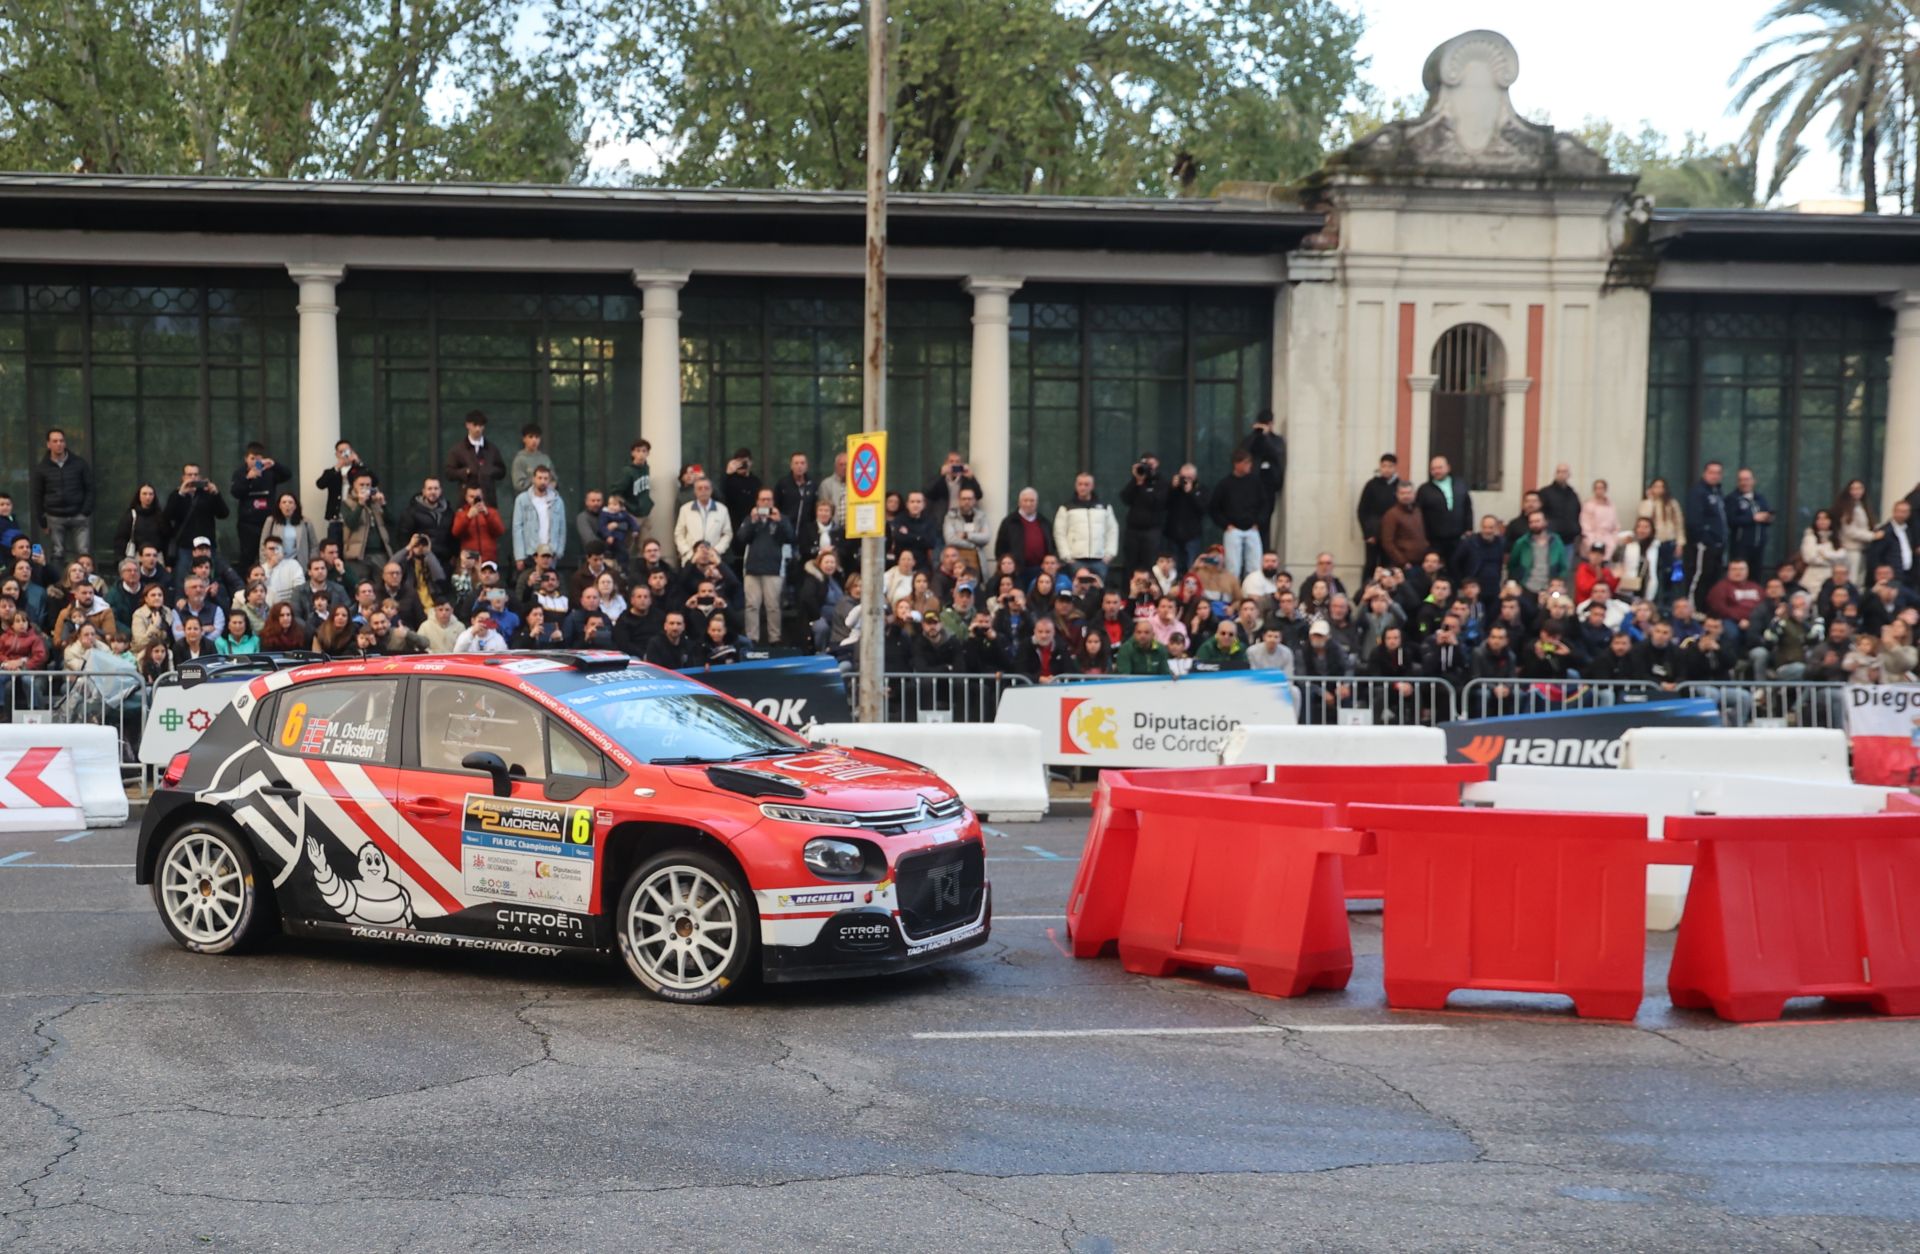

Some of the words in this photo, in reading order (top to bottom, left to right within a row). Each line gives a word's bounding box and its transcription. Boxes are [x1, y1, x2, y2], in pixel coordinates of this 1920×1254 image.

[281, 702, 308, 747] 6
[326, 721, 339, 738] M.
[340, 723, 387, 745] Østberg
[518, 681, 633, 767] boutique.citroenracing.com
[322, 738, 331, 755] T.
[331, 739, 374, 758] Eriksen
[1133, 735, 1151, 751] de
[1162, 735, 1224, 753] Córdo
[512, 806, 560, 822] SIERRA
[500, 817, 560, 834] MORENA
[572, 809, 590, 844] 6
[492, 837, 504, 846] FIA
[505, 838, 517, 848] ERC
[518, 839, 562, 854] Championship
[795, 893, 852, 904] MICHELIN
[496, 909, 584, 930] CITROËN
[840, 925, 889, 935] CITROËN
[350, 926, 393, 940] TAGAI
[396, 932, 451, 946] RACING
[456, 938, 562, 957] TECHNOLOGY
